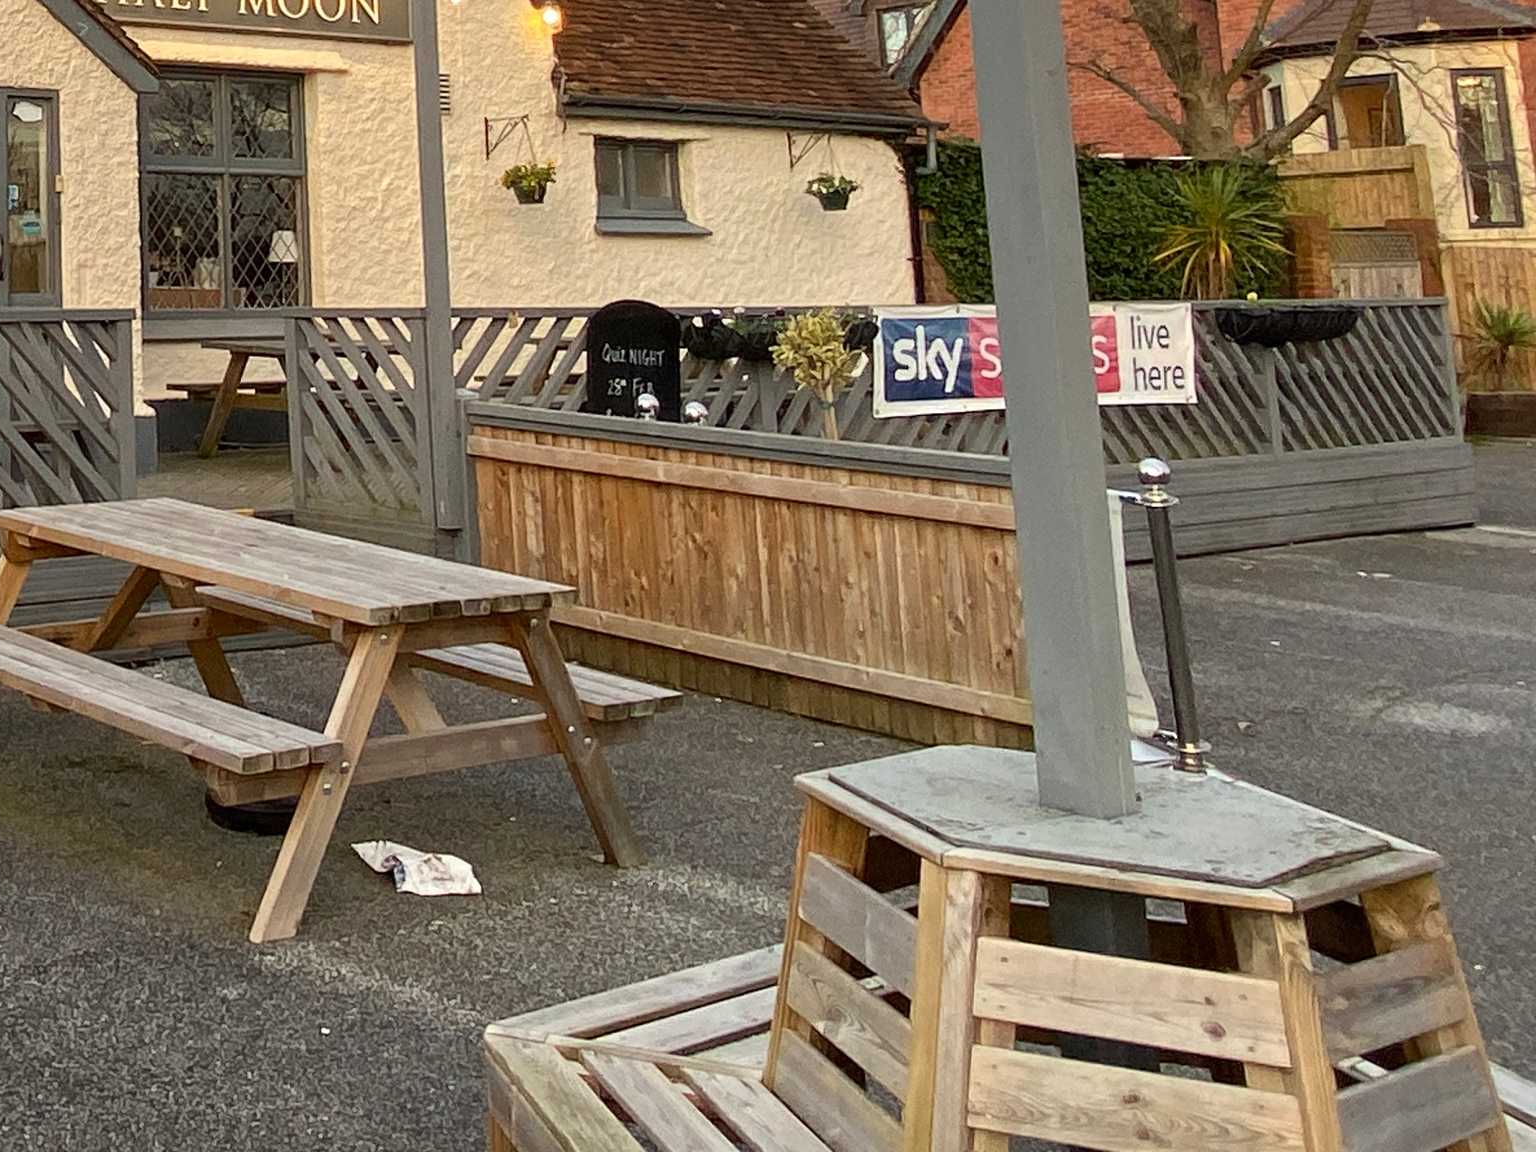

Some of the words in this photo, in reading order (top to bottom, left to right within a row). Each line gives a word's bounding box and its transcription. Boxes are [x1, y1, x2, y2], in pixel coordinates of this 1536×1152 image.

[1130, 316, 1170, 350] live
[629, 348, 664, 367] NIGHT
[892, 324, 963, 393] sky
[1133, 357, 1185, 392] here
